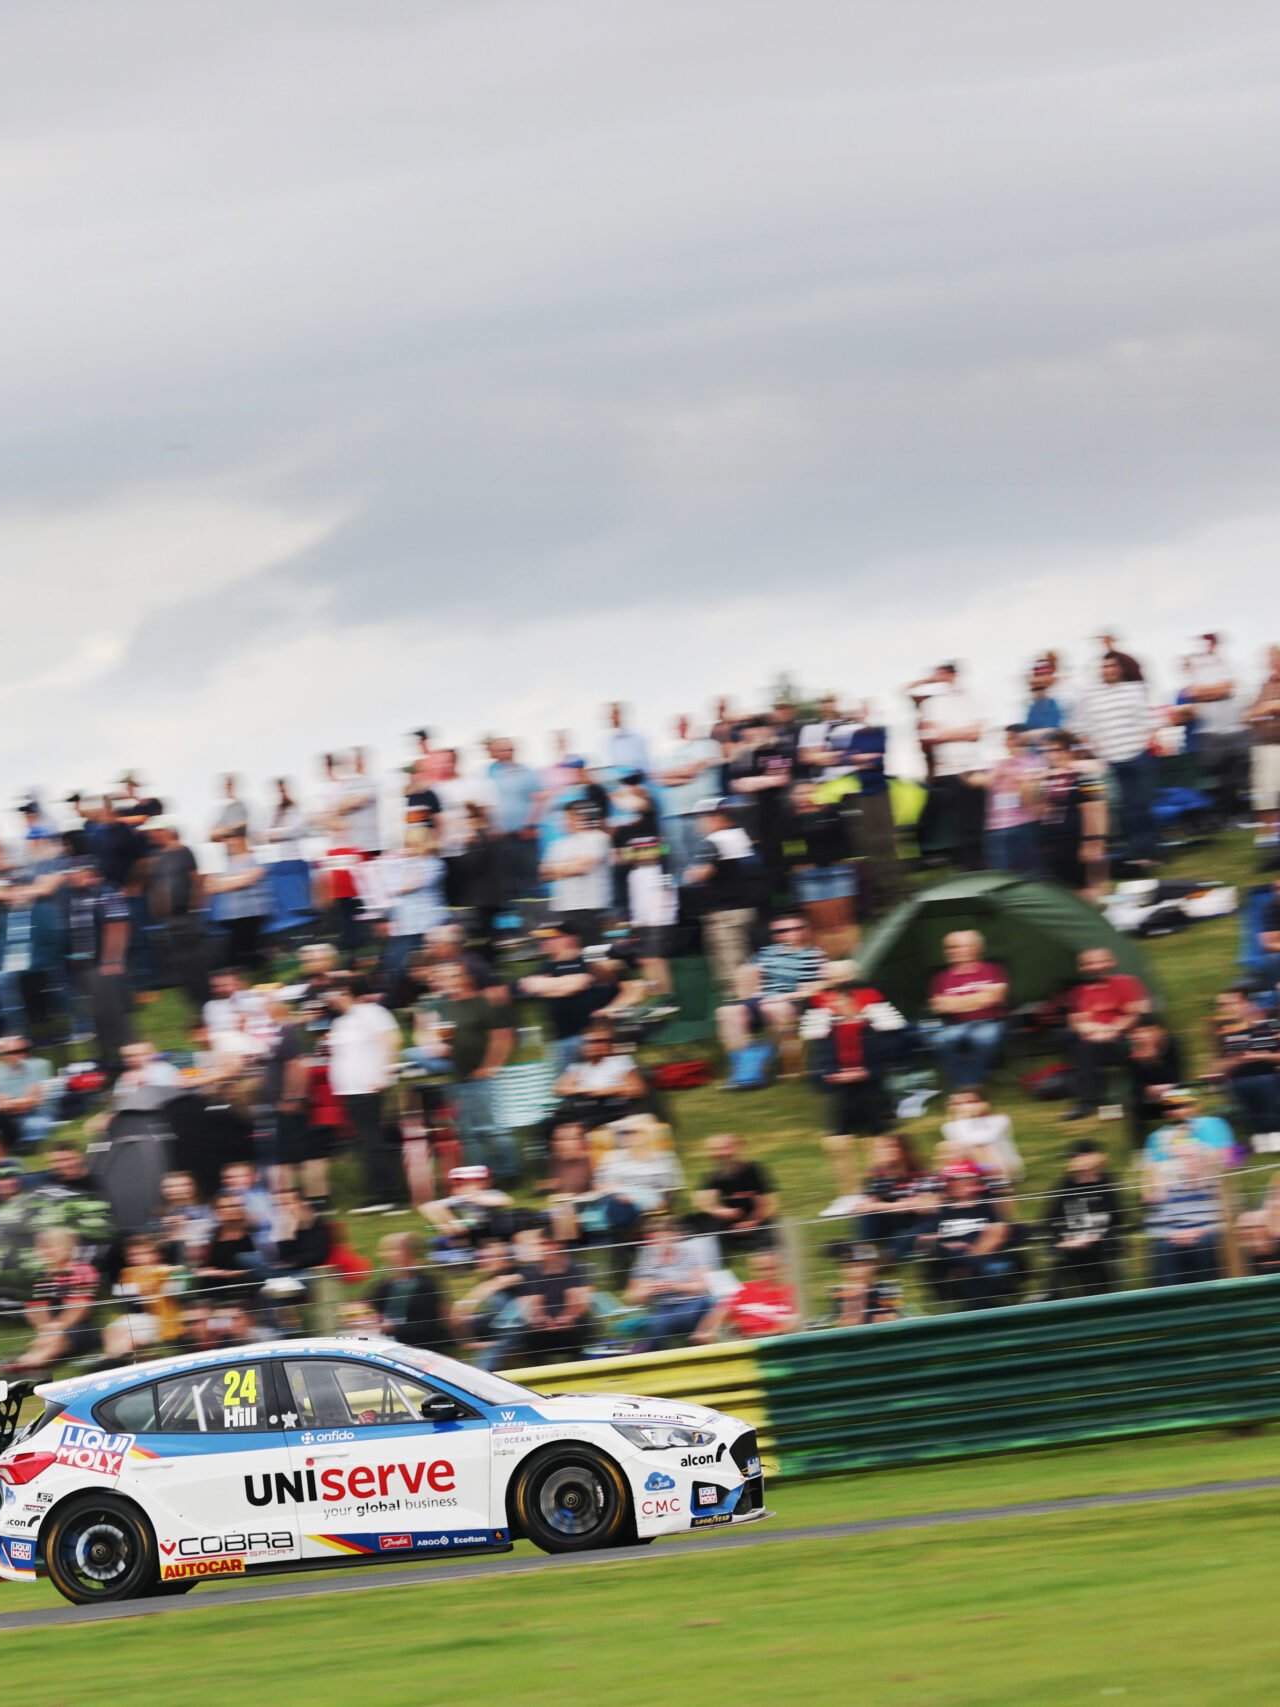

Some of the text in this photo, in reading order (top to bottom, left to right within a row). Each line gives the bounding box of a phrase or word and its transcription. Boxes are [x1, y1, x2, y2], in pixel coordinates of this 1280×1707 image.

[223, 1368, 257, 1406] 24
[224, 1406, 258, 1428] Hill
[63, 1426, 129, 1453] LIQUI
[316, 1430, 355, 1442] onfido
[504, 1435, 532, 1445] OCEAN
[56, 1447, 123, 1475] MOLY
[680, 1453, 714, 1467] alcon
[37, 1492, 53, 1503] JEP
[323, 1496, 458, 1519] your global business
[641, 1498, 681, 1515] CMC
[12, 1542, 31, 1551] LIQUI
[453, 1535, 487, 1545] Ecoflam
[12, 1549, 30, 1559] MOLY
[248, 1548, 294, 1557] SPORT
[163, 1558, 243, 1580] AUTOCAR
